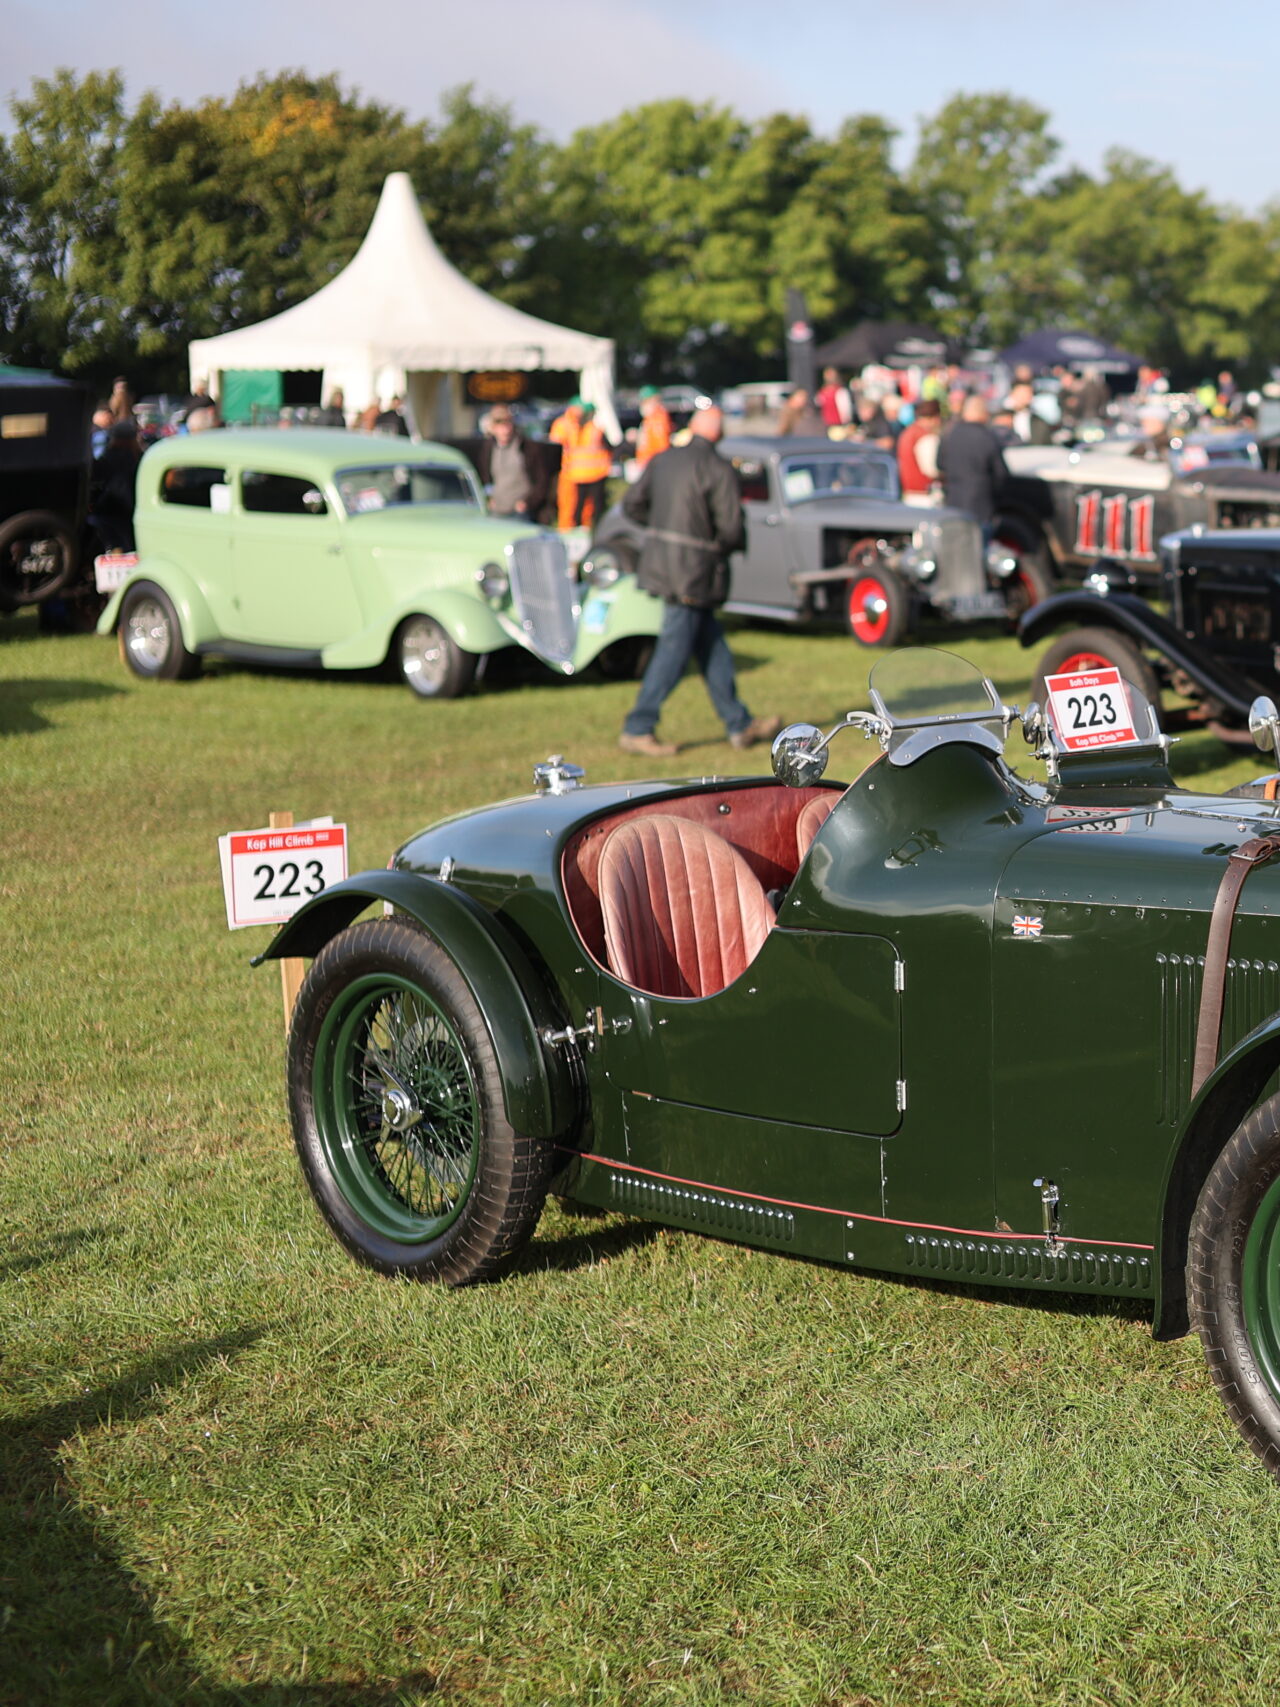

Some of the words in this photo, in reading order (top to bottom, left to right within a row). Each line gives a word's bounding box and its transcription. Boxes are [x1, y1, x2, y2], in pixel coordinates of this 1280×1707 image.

[1074, 489, 1157, 561] 111
[1083, 677, 1099, 686] Days
[1068, 693, 1116, 729] 223
[247, 837, 266, 852] Kop
[269, 836, 283, 848] Hill
[285, 833, 314, 847] Climb
[254, 861, 325, 900] 223
